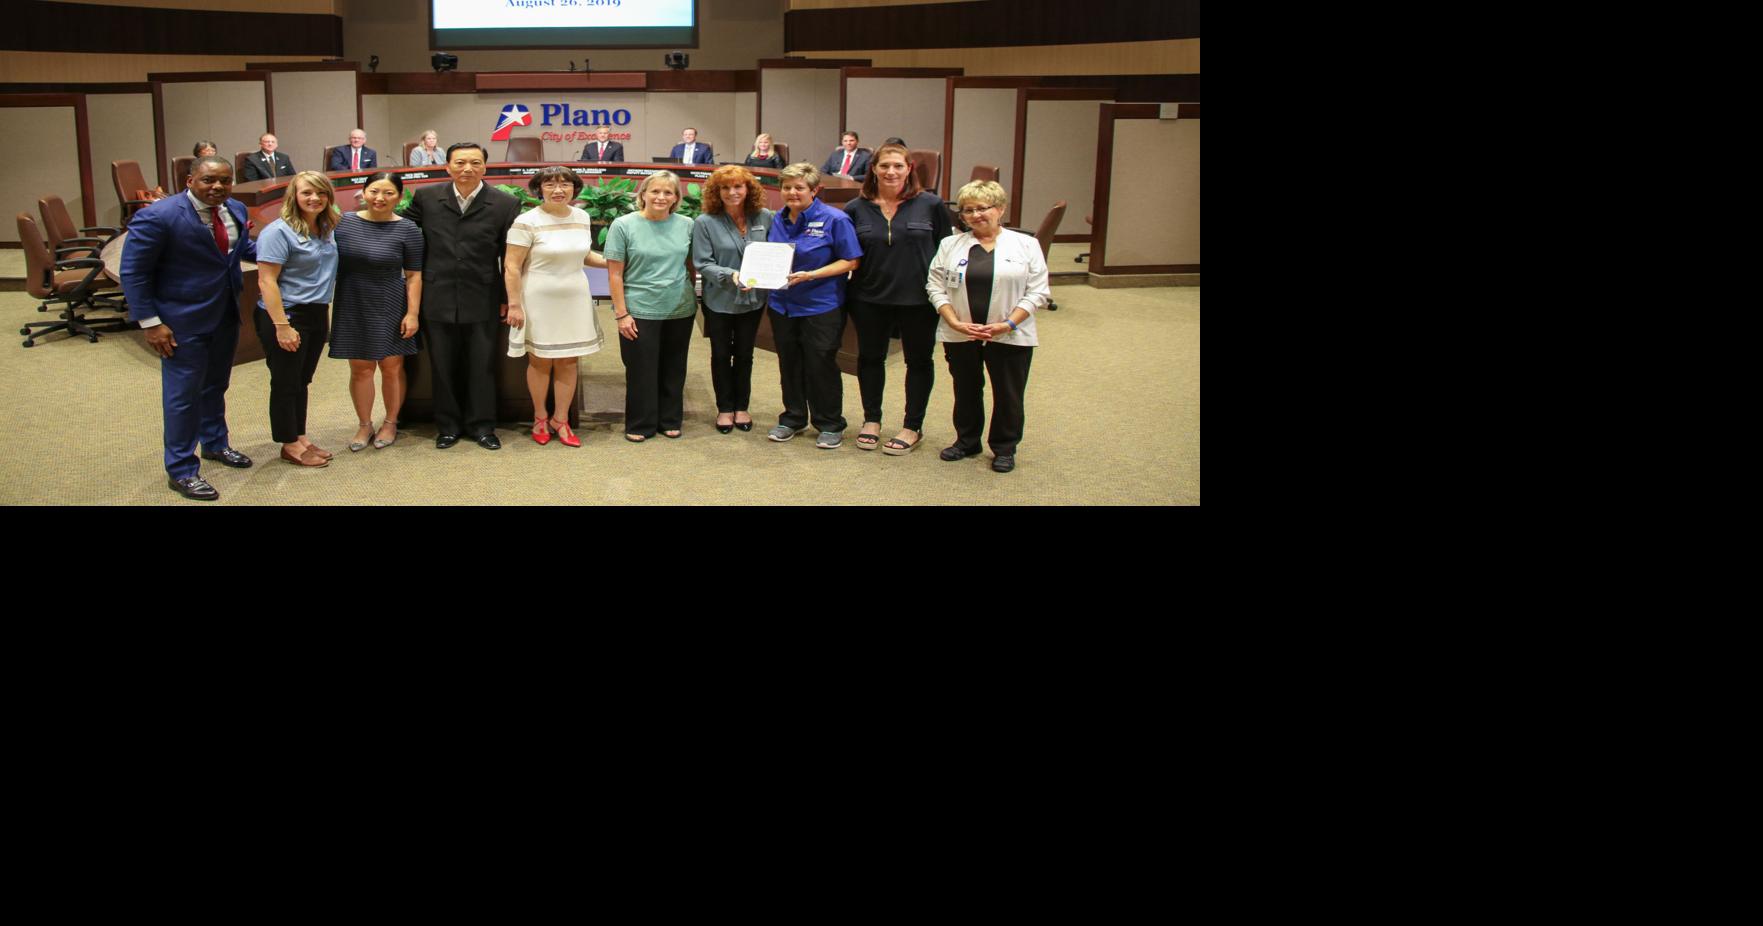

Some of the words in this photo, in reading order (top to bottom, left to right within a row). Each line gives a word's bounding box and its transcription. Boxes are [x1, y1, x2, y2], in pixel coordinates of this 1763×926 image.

[505, 0, 555, 8] August
[540, 103, 631, 126] Plano
[541, 131, 562, 142] City
[565, 131, 577, 142] of
